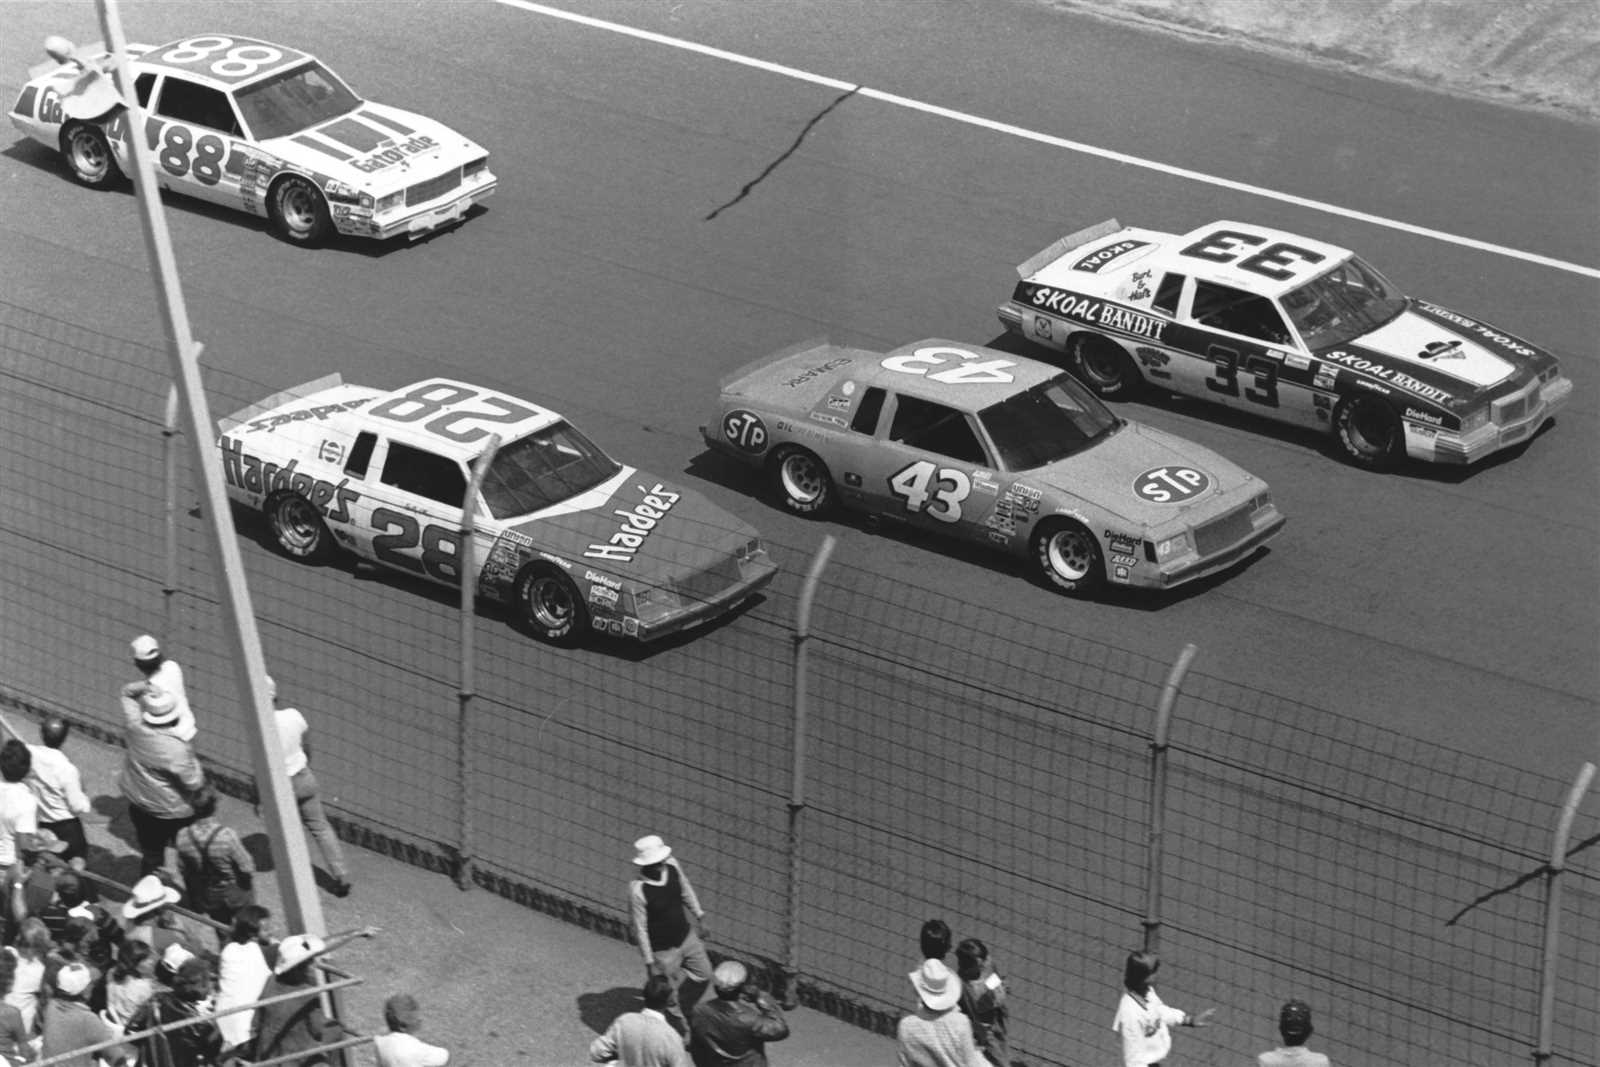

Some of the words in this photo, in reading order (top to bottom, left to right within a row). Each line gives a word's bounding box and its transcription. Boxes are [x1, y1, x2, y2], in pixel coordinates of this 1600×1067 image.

[161, 36, 282, 76] 88
[160, 125, 225, 186] 88
[350, 135, 439, 173] Gatorade
[1080, 241, 1136, 269] SKOAL
[1179, 230, 1327, 282] 33
[1032, 287, 1100, 321] SKOAL
[1099, 306, 1168, 340] BANDIT
[1476, 320, 1537, 357] SKOAL
[880, 347, 1018, 384] 43
[1205, 344, 1280, 409] 33
[1326, 351, 1394, 378] SKOAL
[1391, 372, 1451, 404] BANDIT
[368, 383, 540, 443] 28
[726, 412, 766, 447] STP
[777, 420, 794, 432] OIL
[1405, 407, 1443, 425] DieHard
[221, 435, 361, 523] Hardee's
[889, 460, 971, 523] 43
[1141, 468, 1202, 502] STP
[583, 483, 681, 562] Hardee's
[1104, 530, 1142, 546] DieHard
[371, 507, 464, 589] 28
